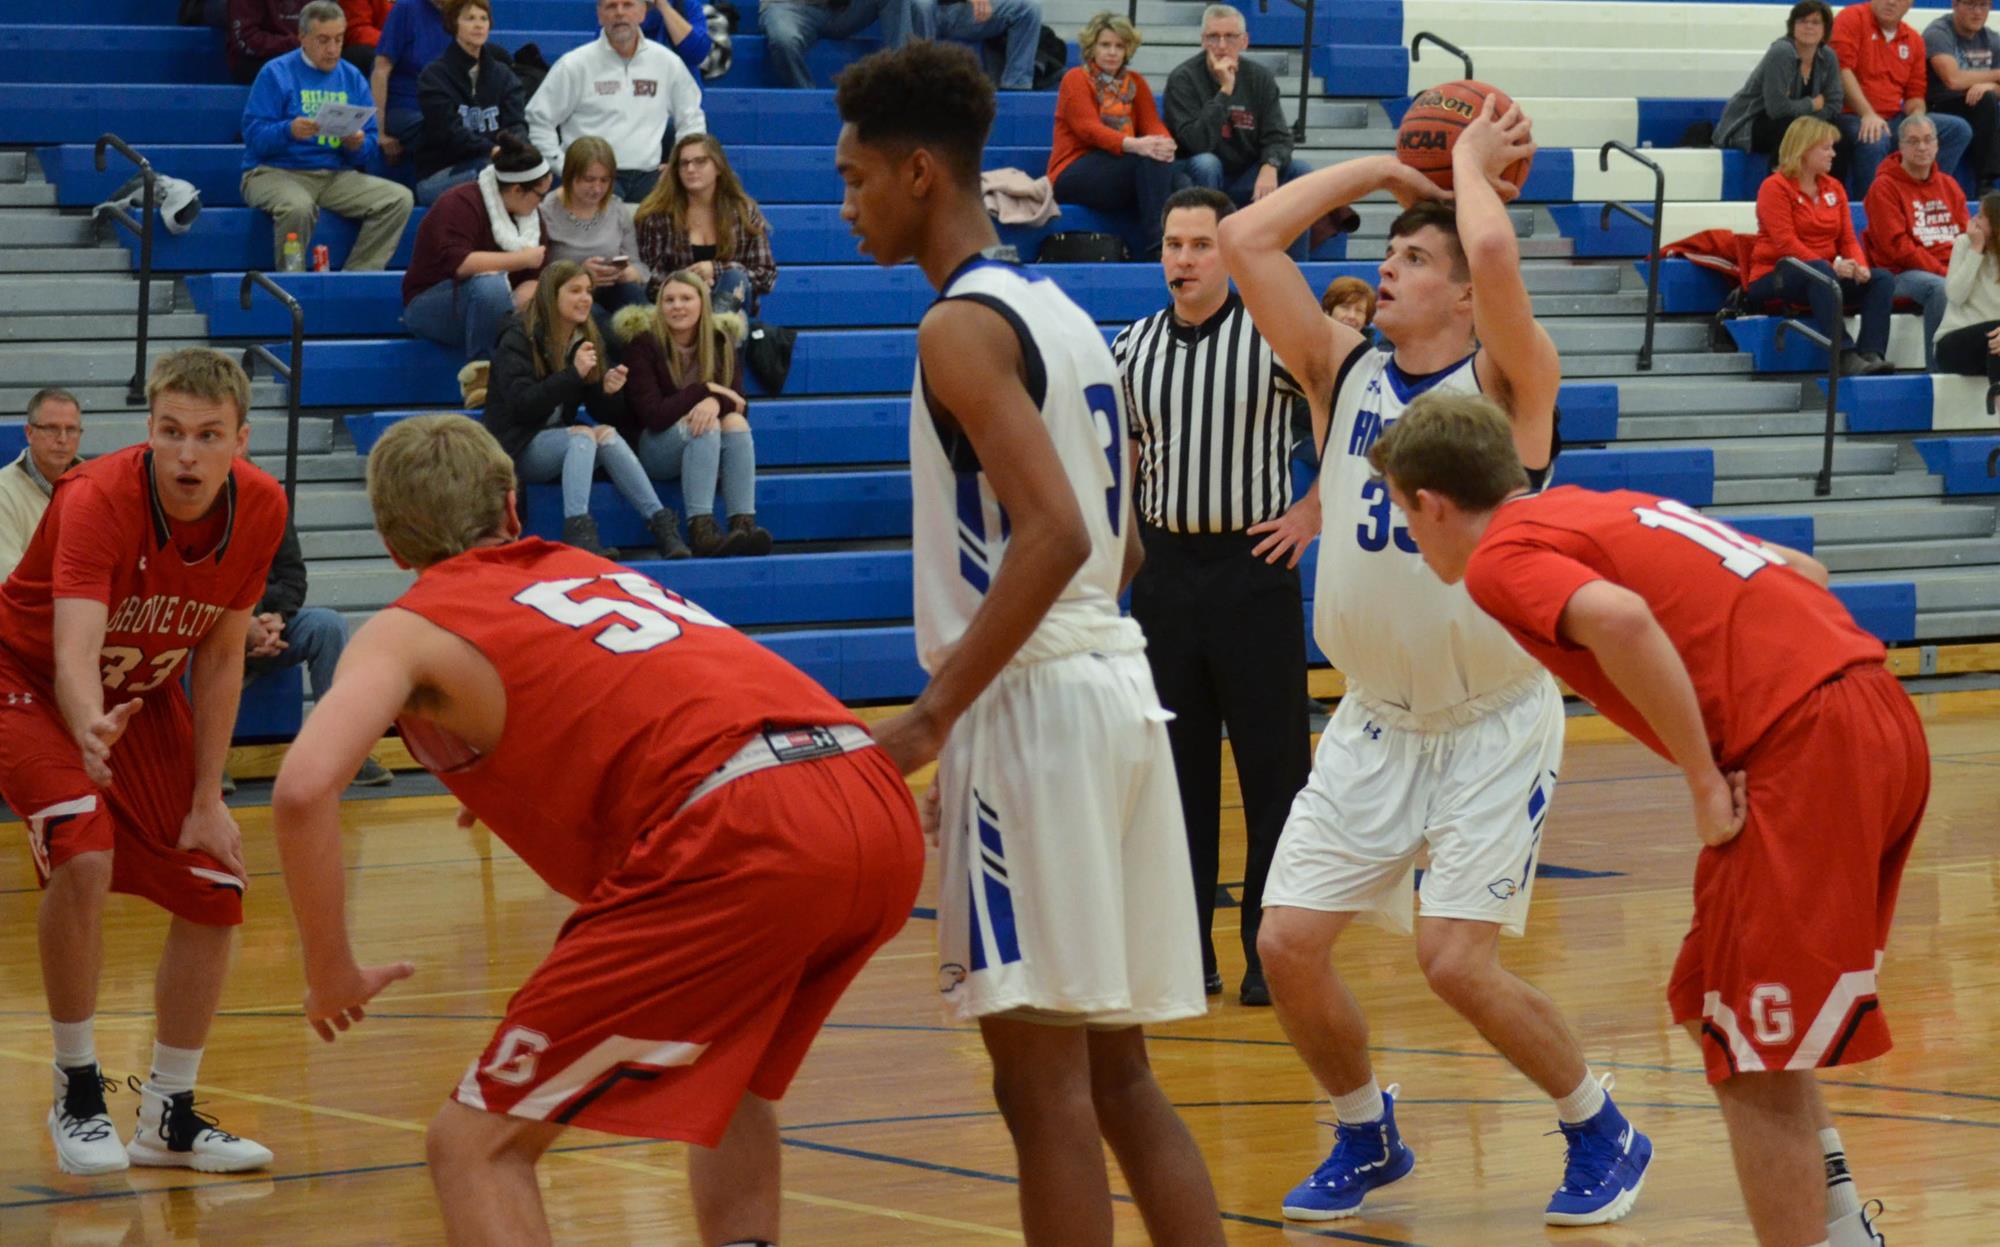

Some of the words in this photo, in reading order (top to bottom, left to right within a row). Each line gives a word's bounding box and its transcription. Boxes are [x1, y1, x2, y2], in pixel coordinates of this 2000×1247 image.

[106, 595, 180, 634] GROVE
[1749, 983, 1794, 1046] G
[481, 1024, 553, 1087] G
